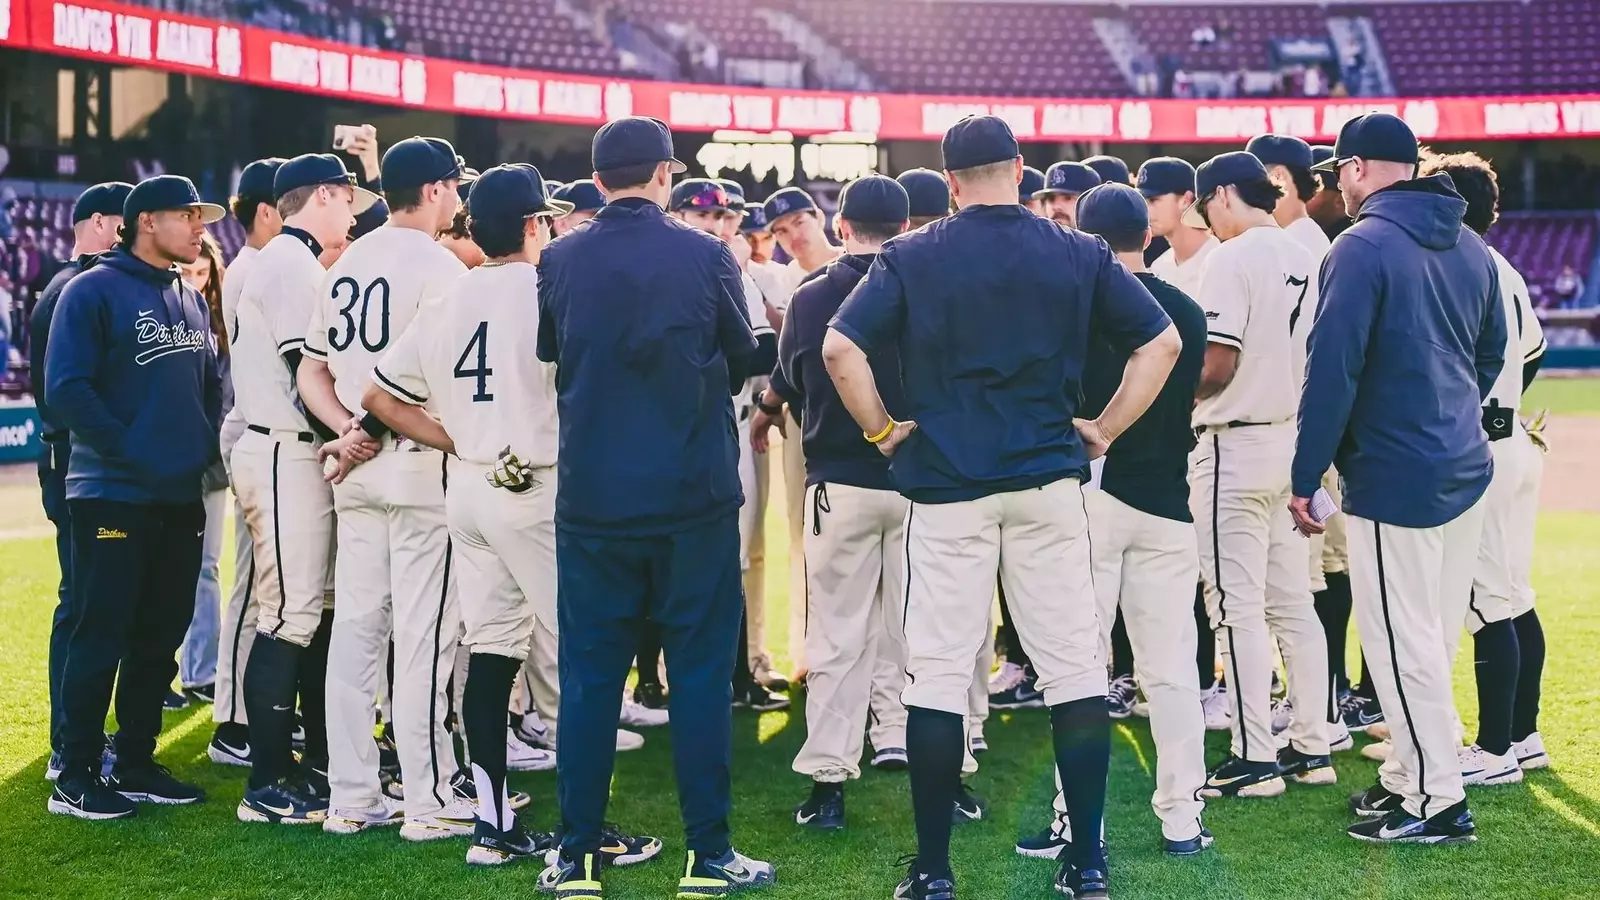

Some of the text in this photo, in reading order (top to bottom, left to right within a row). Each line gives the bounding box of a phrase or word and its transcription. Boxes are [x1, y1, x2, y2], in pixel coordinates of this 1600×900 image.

[328, 276, 390, 353] 30
[1284, 273, 1309, 338] 7
[453, 321, 494, 402] 4
